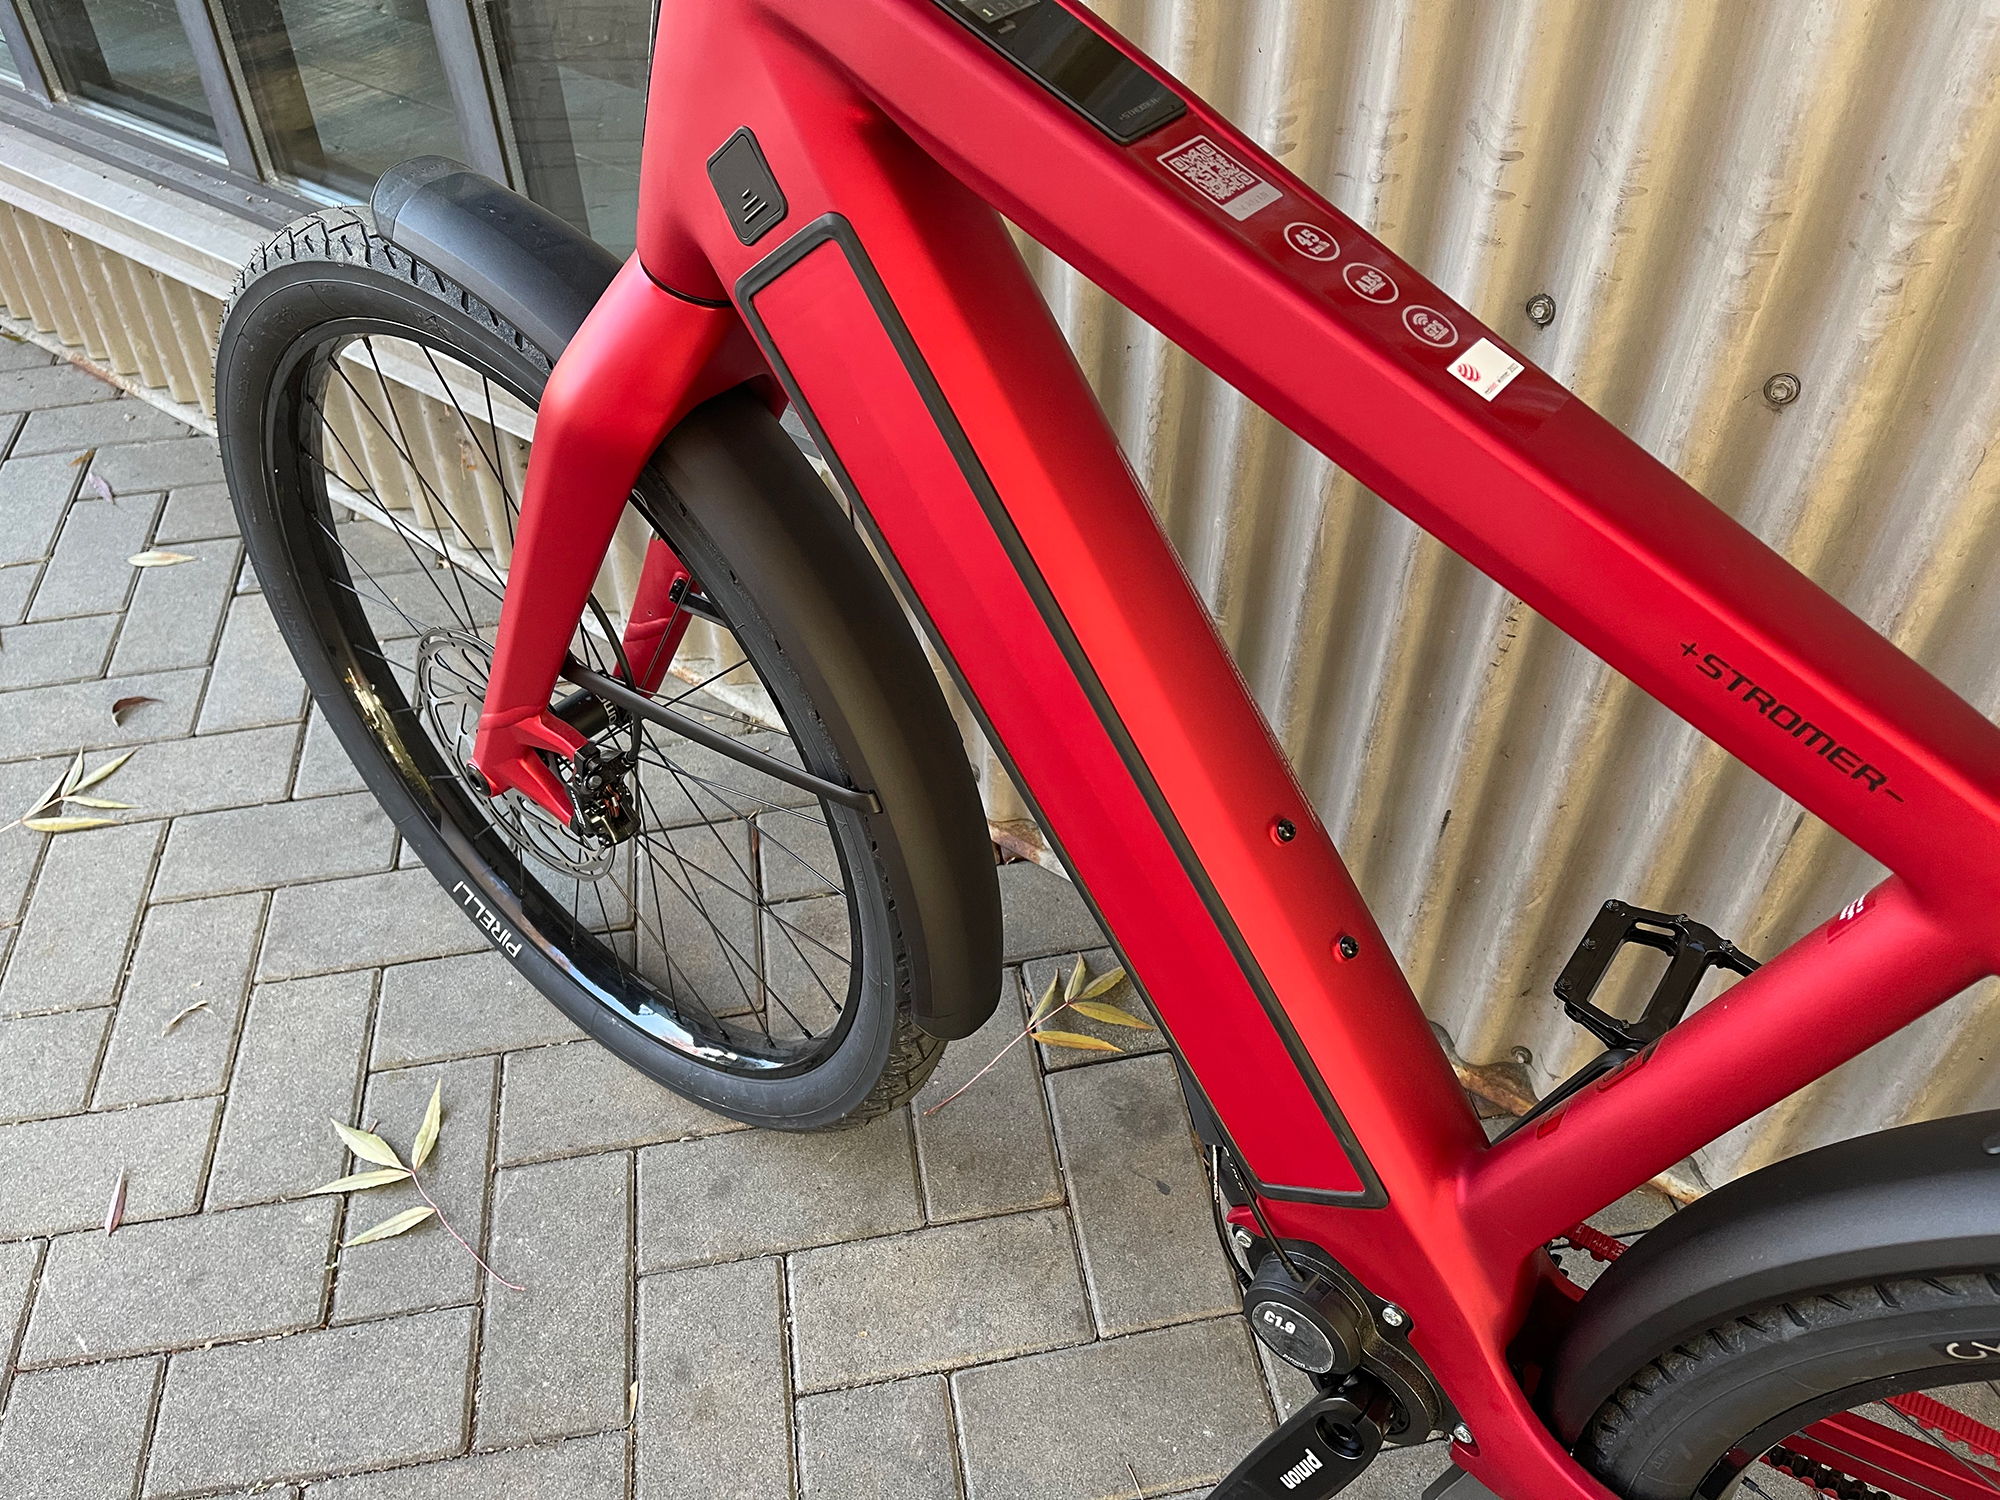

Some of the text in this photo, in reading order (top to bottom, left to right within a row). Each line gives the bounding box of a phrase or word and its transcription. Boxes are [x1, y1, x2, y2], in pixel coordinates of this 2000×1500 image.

[982, 8, 994, 17] 1
[1295, 228, 1320, 247] 45
[1355, 270, 1382, 293] ABS
[1423, 319, 1444, 338] GPS
[452, 880, 523, 958] PIRELLI
[1263, 1310, 1297, 1335] C1.9
[1279, 1448, 1324, 1490] pinion
